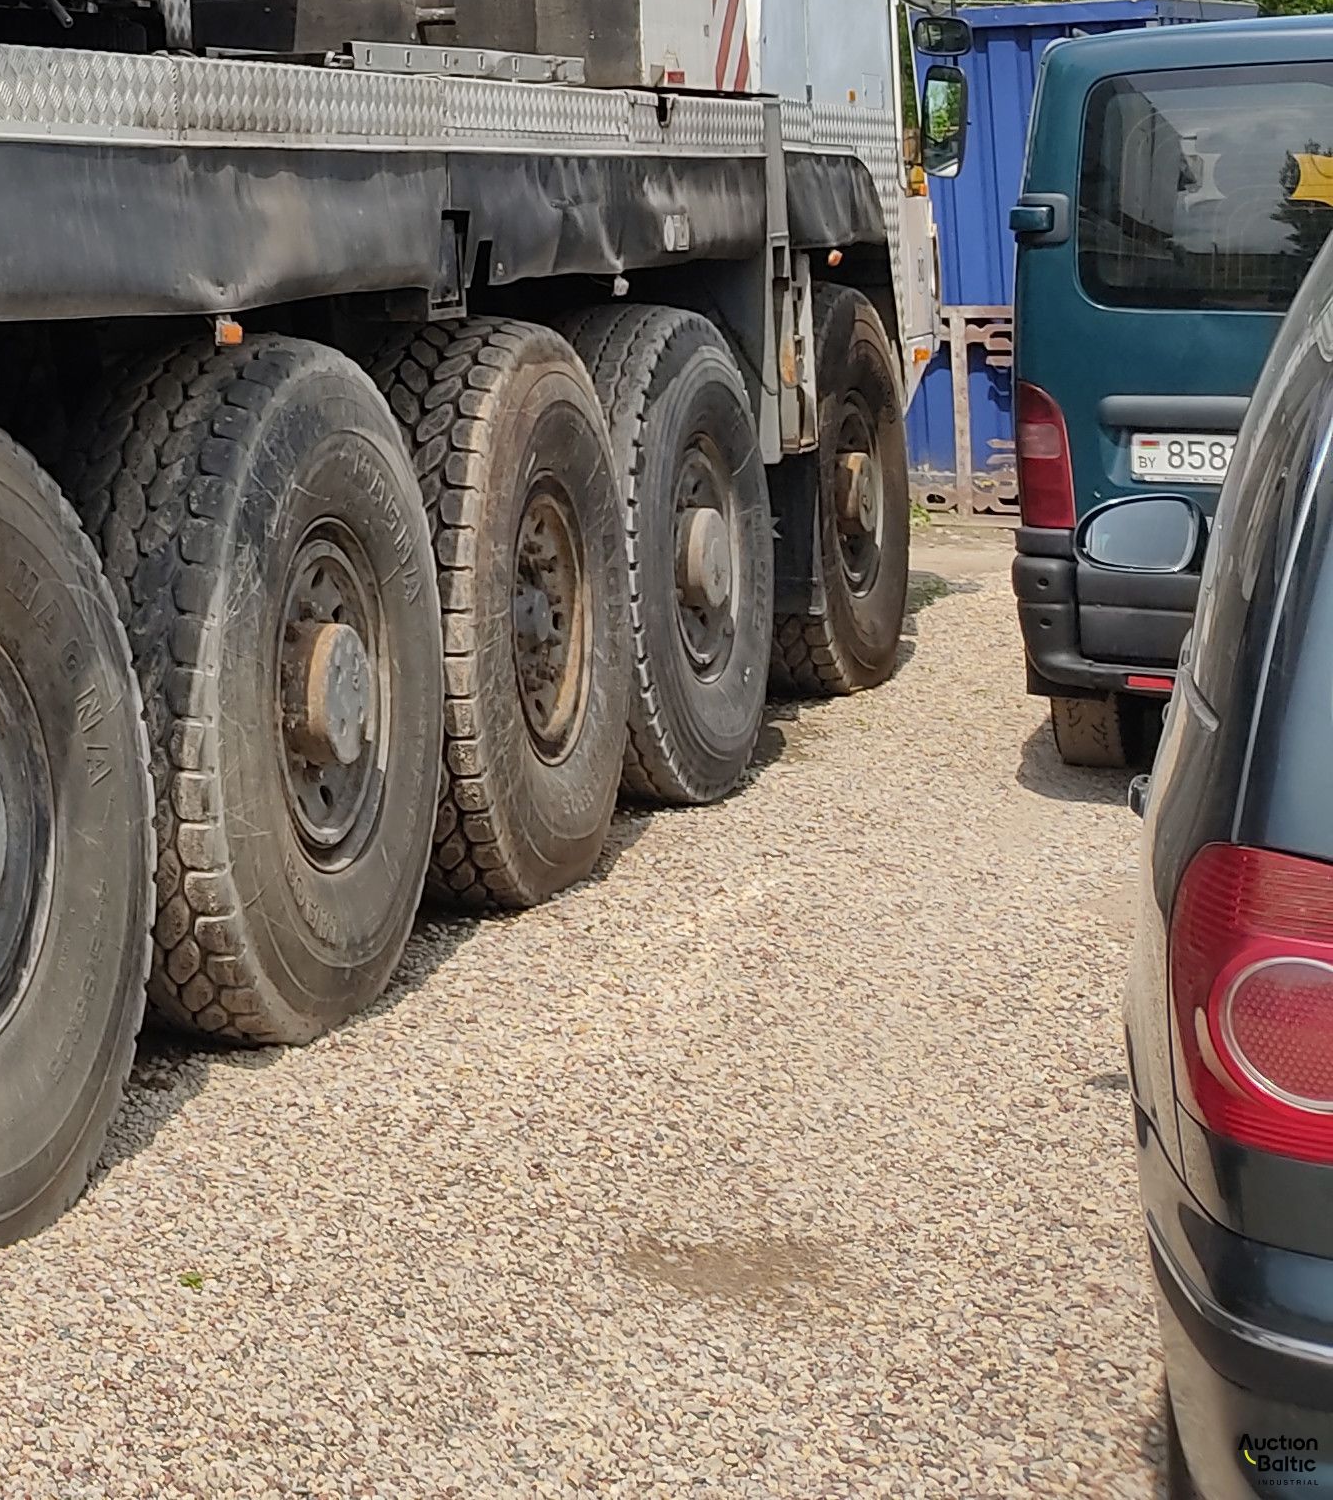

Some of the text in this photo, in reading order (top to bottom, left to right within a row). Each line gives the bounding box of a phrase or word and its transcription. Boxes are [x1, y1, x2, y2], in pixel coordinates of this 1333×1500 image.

[1138, 456, 1156, 469] BY
[1167, 439, 1235, 471] 858
[5, 557, 114, 789] MAGNA
